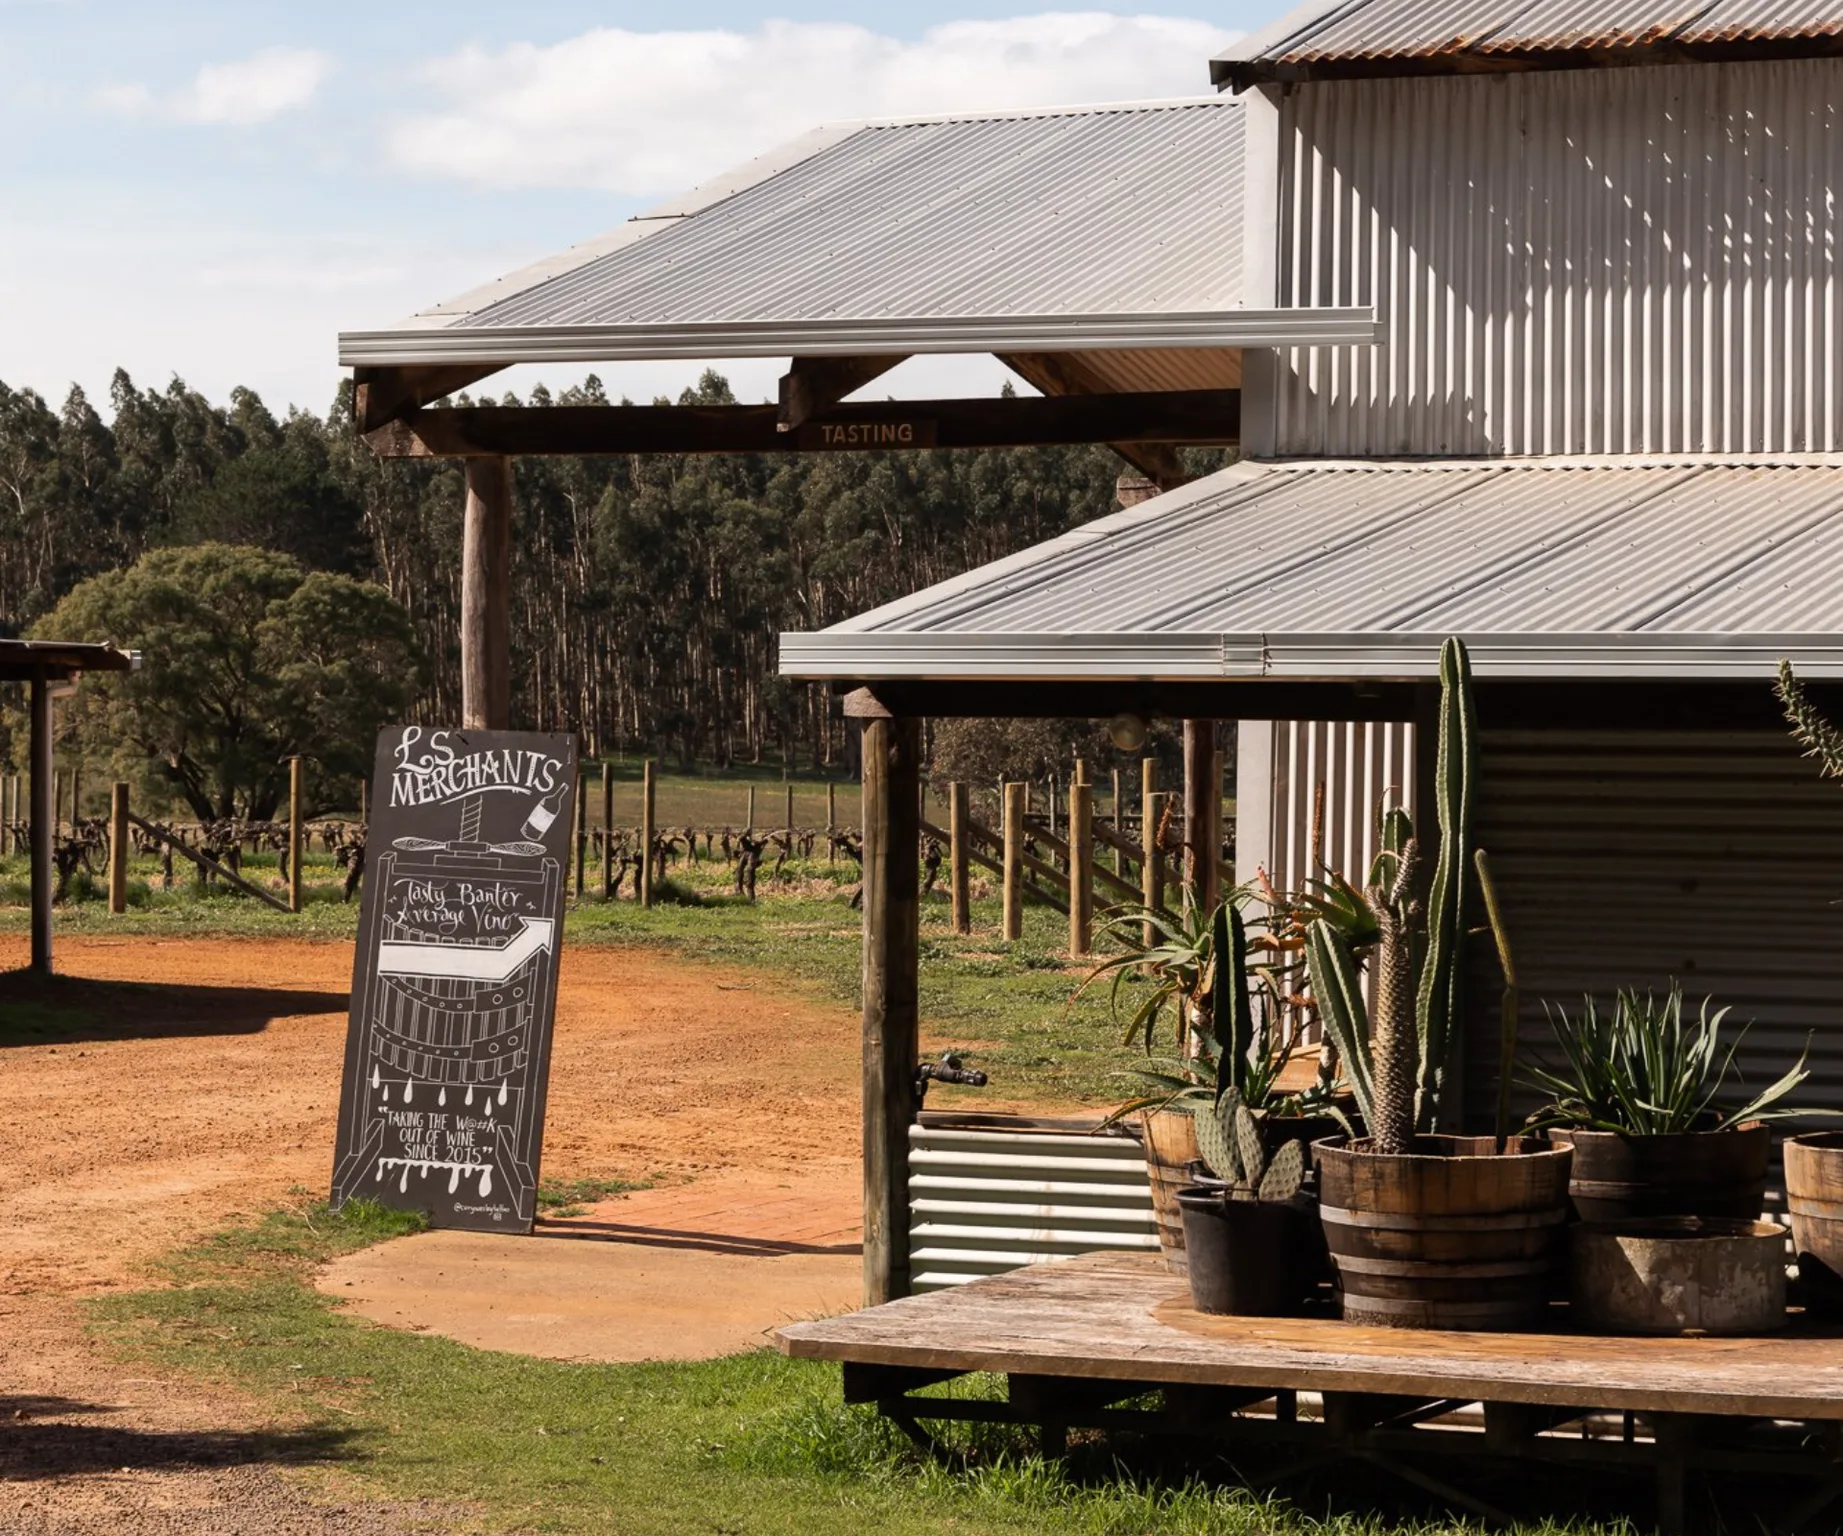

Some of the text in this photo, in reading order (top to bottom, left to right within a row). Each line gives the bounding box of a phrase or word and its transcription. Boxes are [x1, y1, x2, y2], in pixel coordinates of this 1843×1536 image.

[821, 423, 912, 443] TASTING
[395, 725, 454, 774] LS
[389, 749, 563, 807] MERCHANTS
[394, 878, 523, 912] Tasty Banter
[472, 903, 520, 934] Vino
[428, 1112, 449, 1130] THE
[399, 1127, 476, 1147] OUT OF WINE
[404, 1142, 438, 1161] SINCE
